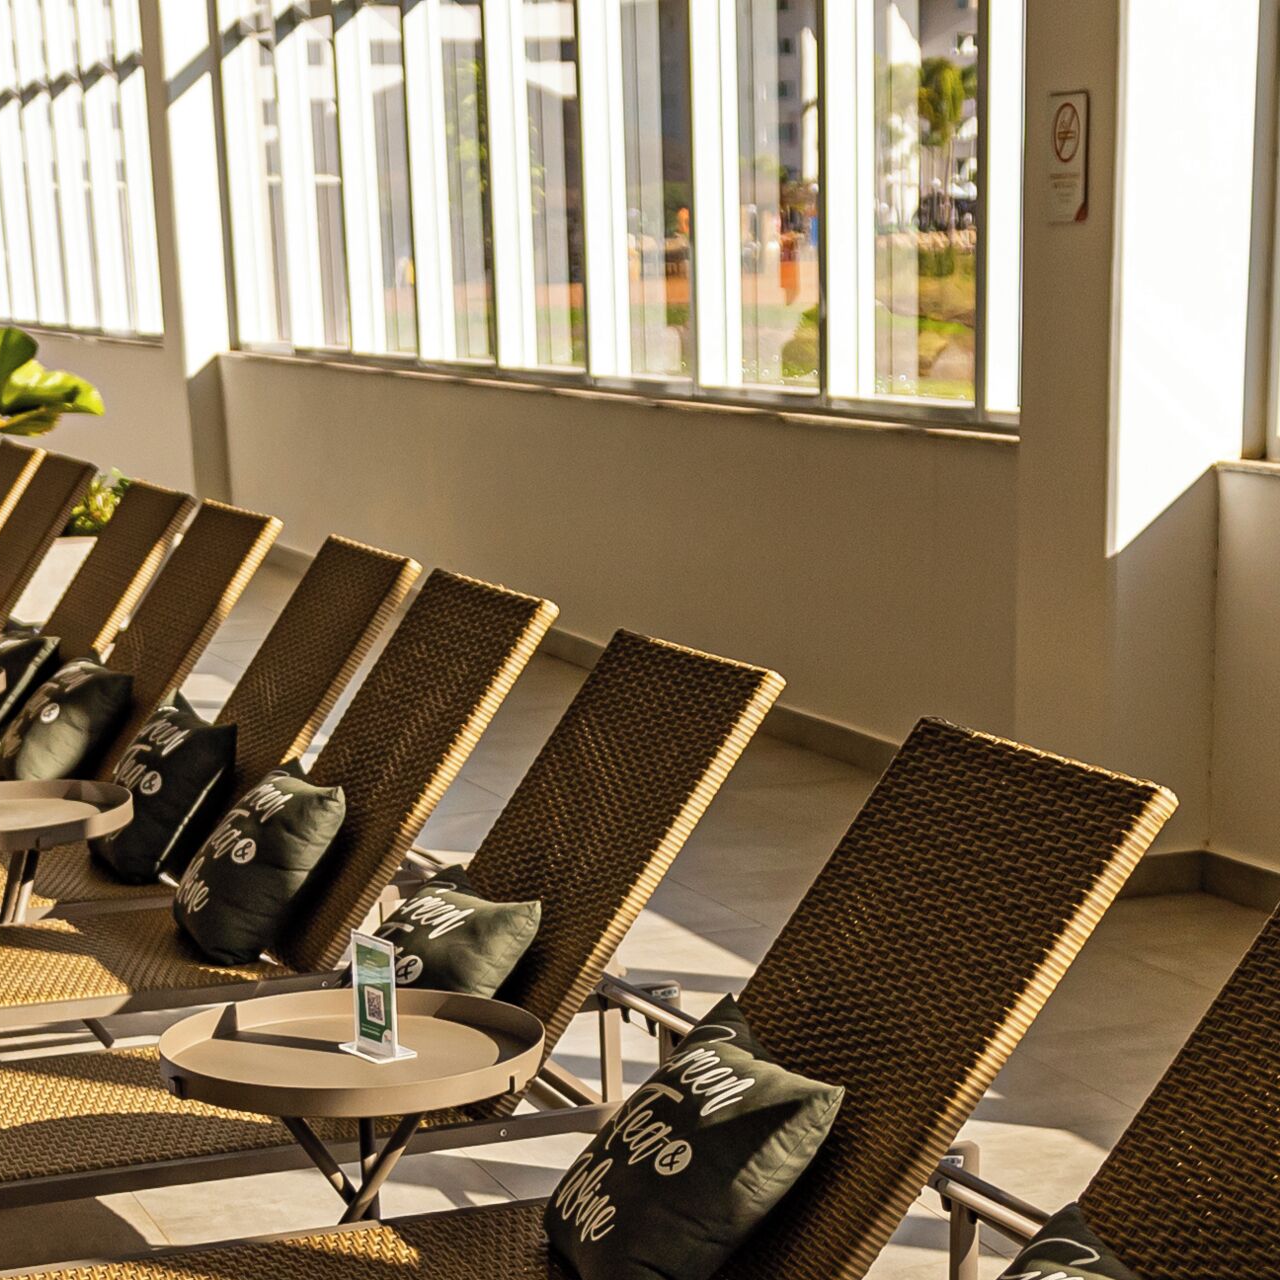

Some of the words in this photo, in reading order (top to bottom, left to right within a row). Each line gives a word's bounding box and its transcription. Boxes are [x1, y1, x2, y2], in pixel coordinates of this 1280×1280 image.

[232, 840, 255, 862] &
[395, 957, 420, 981] &
[605, 1082, 685, 1166] Tea
[657, 1142, 689, 1172] &
